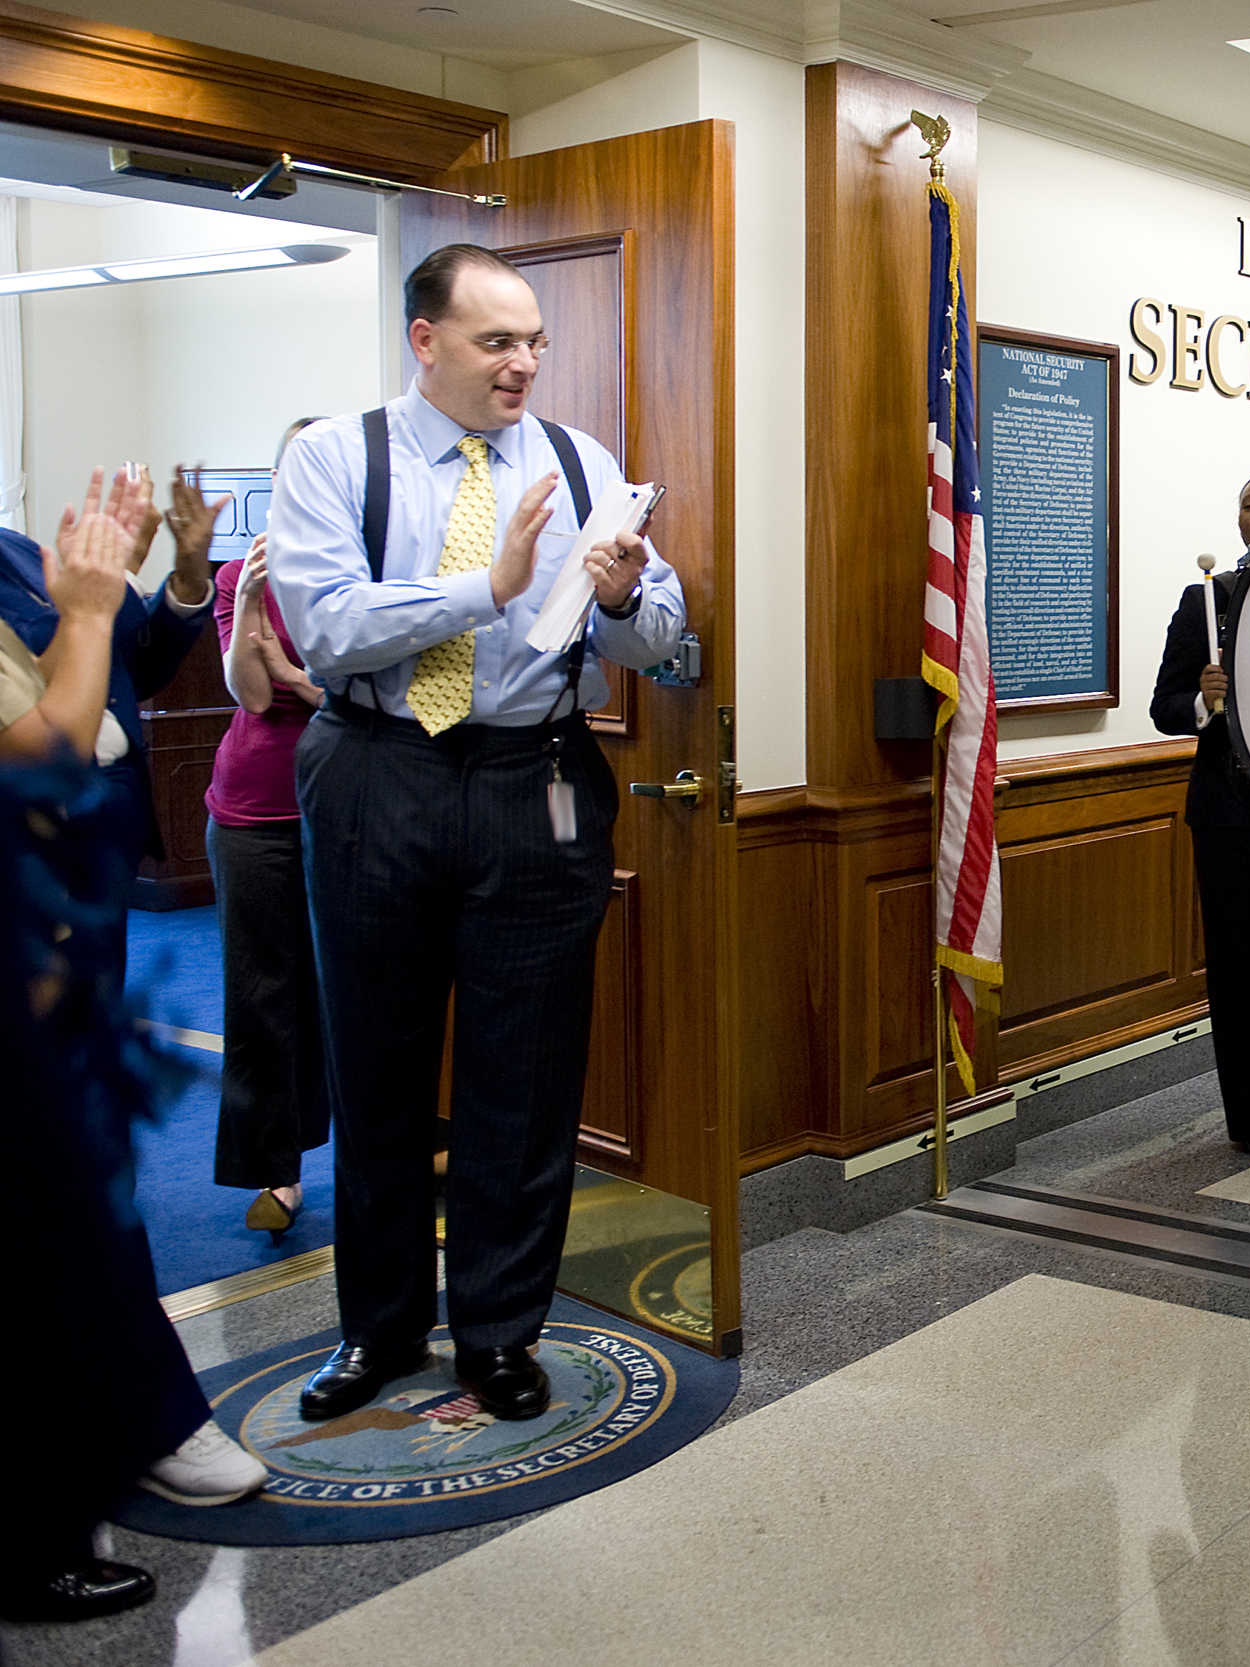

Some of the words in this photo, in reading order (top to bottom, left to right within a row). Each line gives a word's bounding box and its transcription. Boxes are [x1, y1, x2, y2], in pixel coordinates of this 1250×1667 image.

[1002, 348, 1045, 365] NATIONAL
[1046, 355, 1086, 371] SECURITY
[1021, 364, 1037, 375] ACT
[1039, 367, 1050, 377] OF
[1051, 369, 1068, 380] 1947
[1008, 387, 1050, 403] Declaration
[1050, 394, 1059, 403] of
[1059, 394, 1080, 408] Policy
[579, 1334, 658, 1382] DEFENSE
[630, 1383, 659, 1400] OF
[496, 1402, 652, 1482] SECRETARY
[352, 1482, 407, 1500] OF
[415, 1471, 496, 1496] THE
